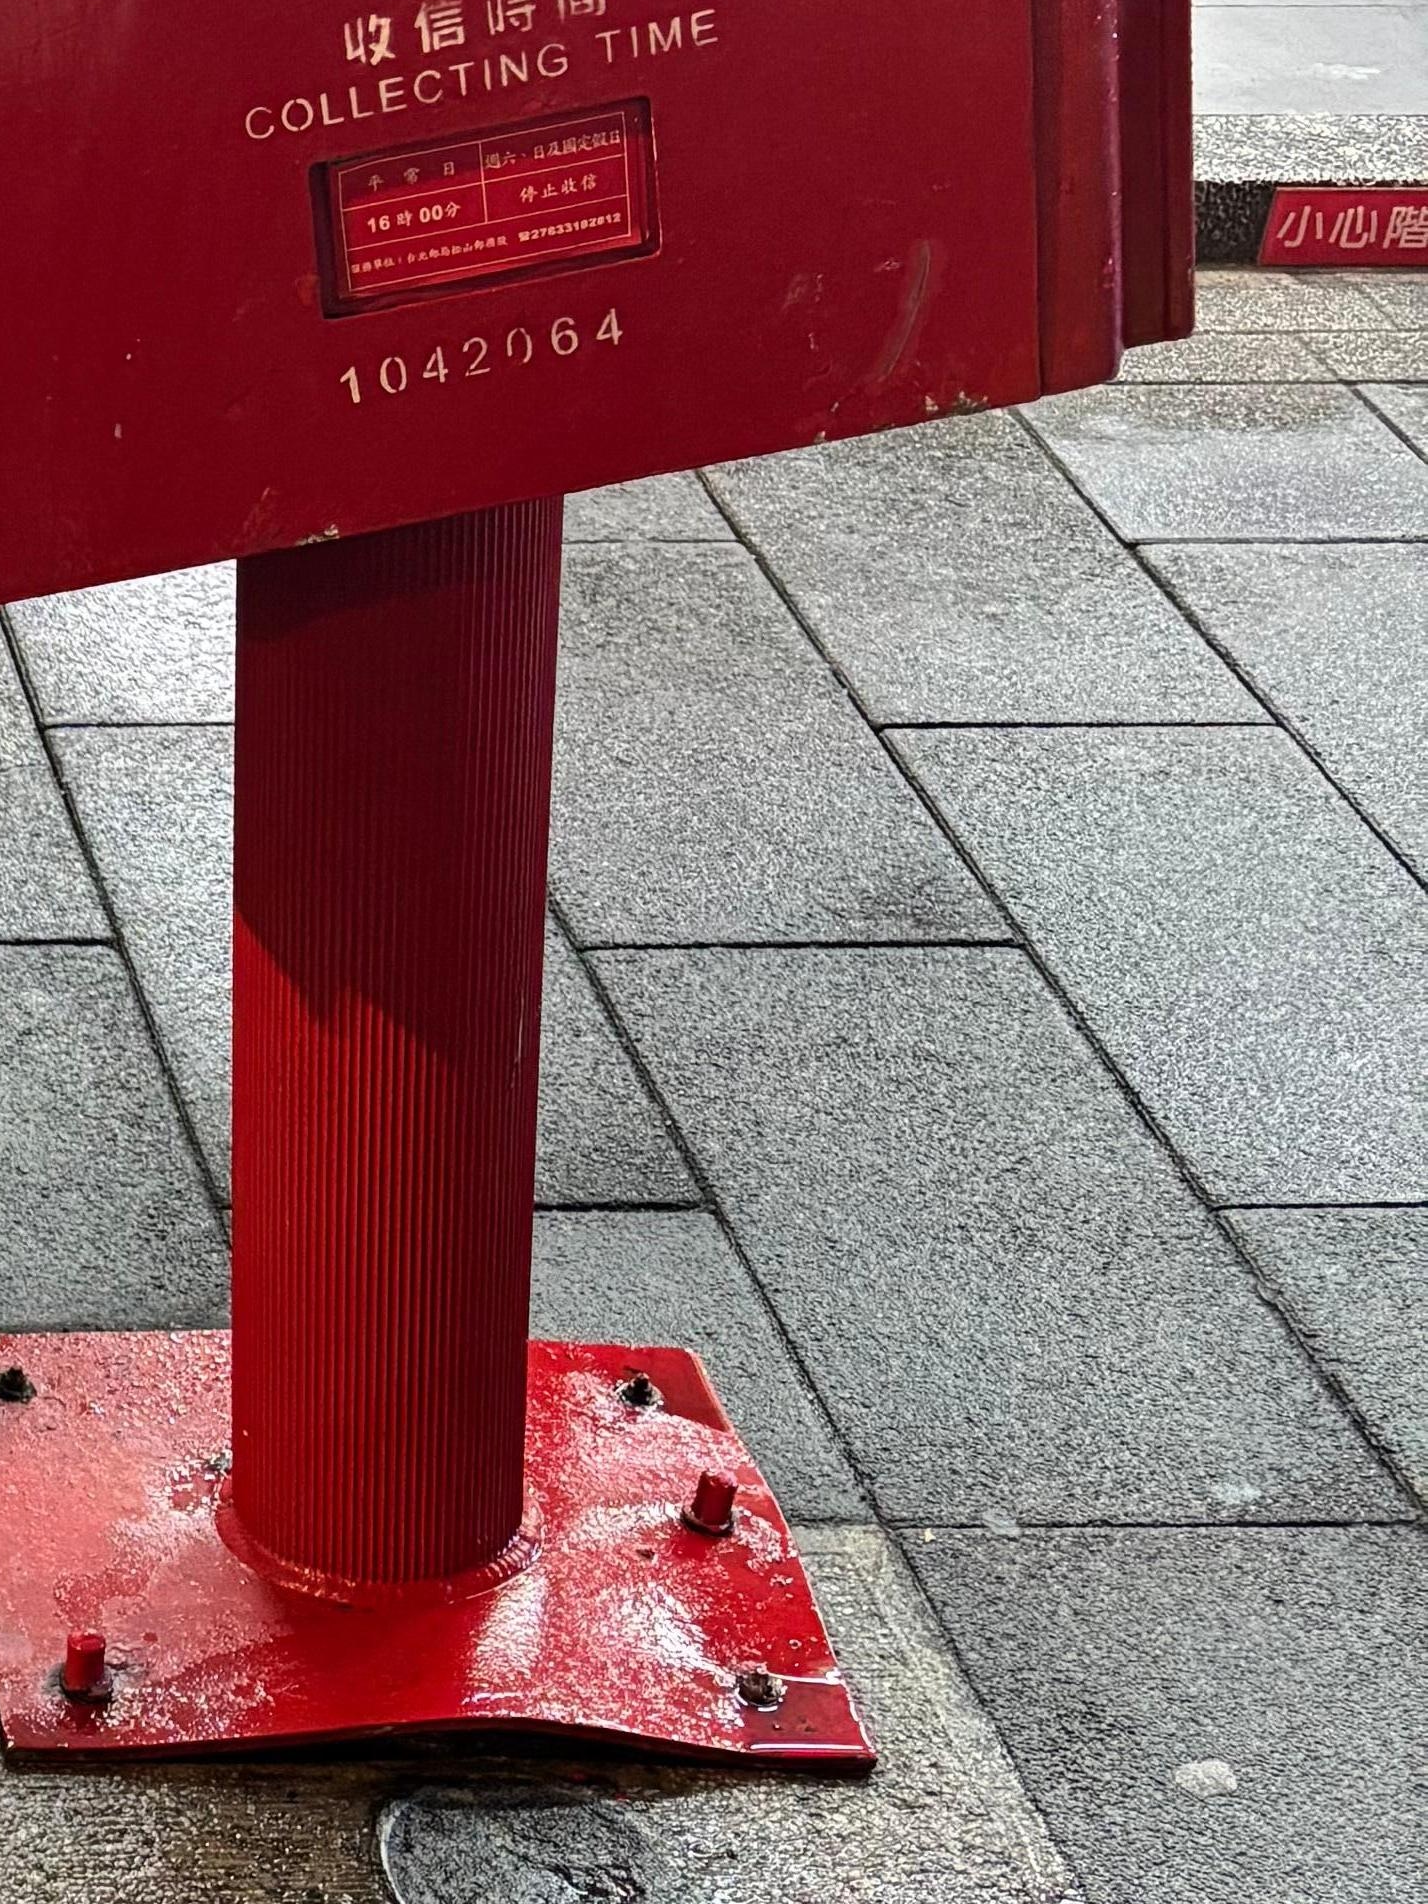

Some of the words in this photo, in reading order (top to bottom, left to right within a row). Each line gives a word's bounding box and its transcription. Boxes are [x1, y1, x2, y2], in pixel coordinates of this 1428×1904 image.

[245, 42, 570, 140] COLLECTING
[595, 8, 719, 64] TIME
[519, 174, 598, 203] 停止收信
[339, 307, 624, 404] 1042064
